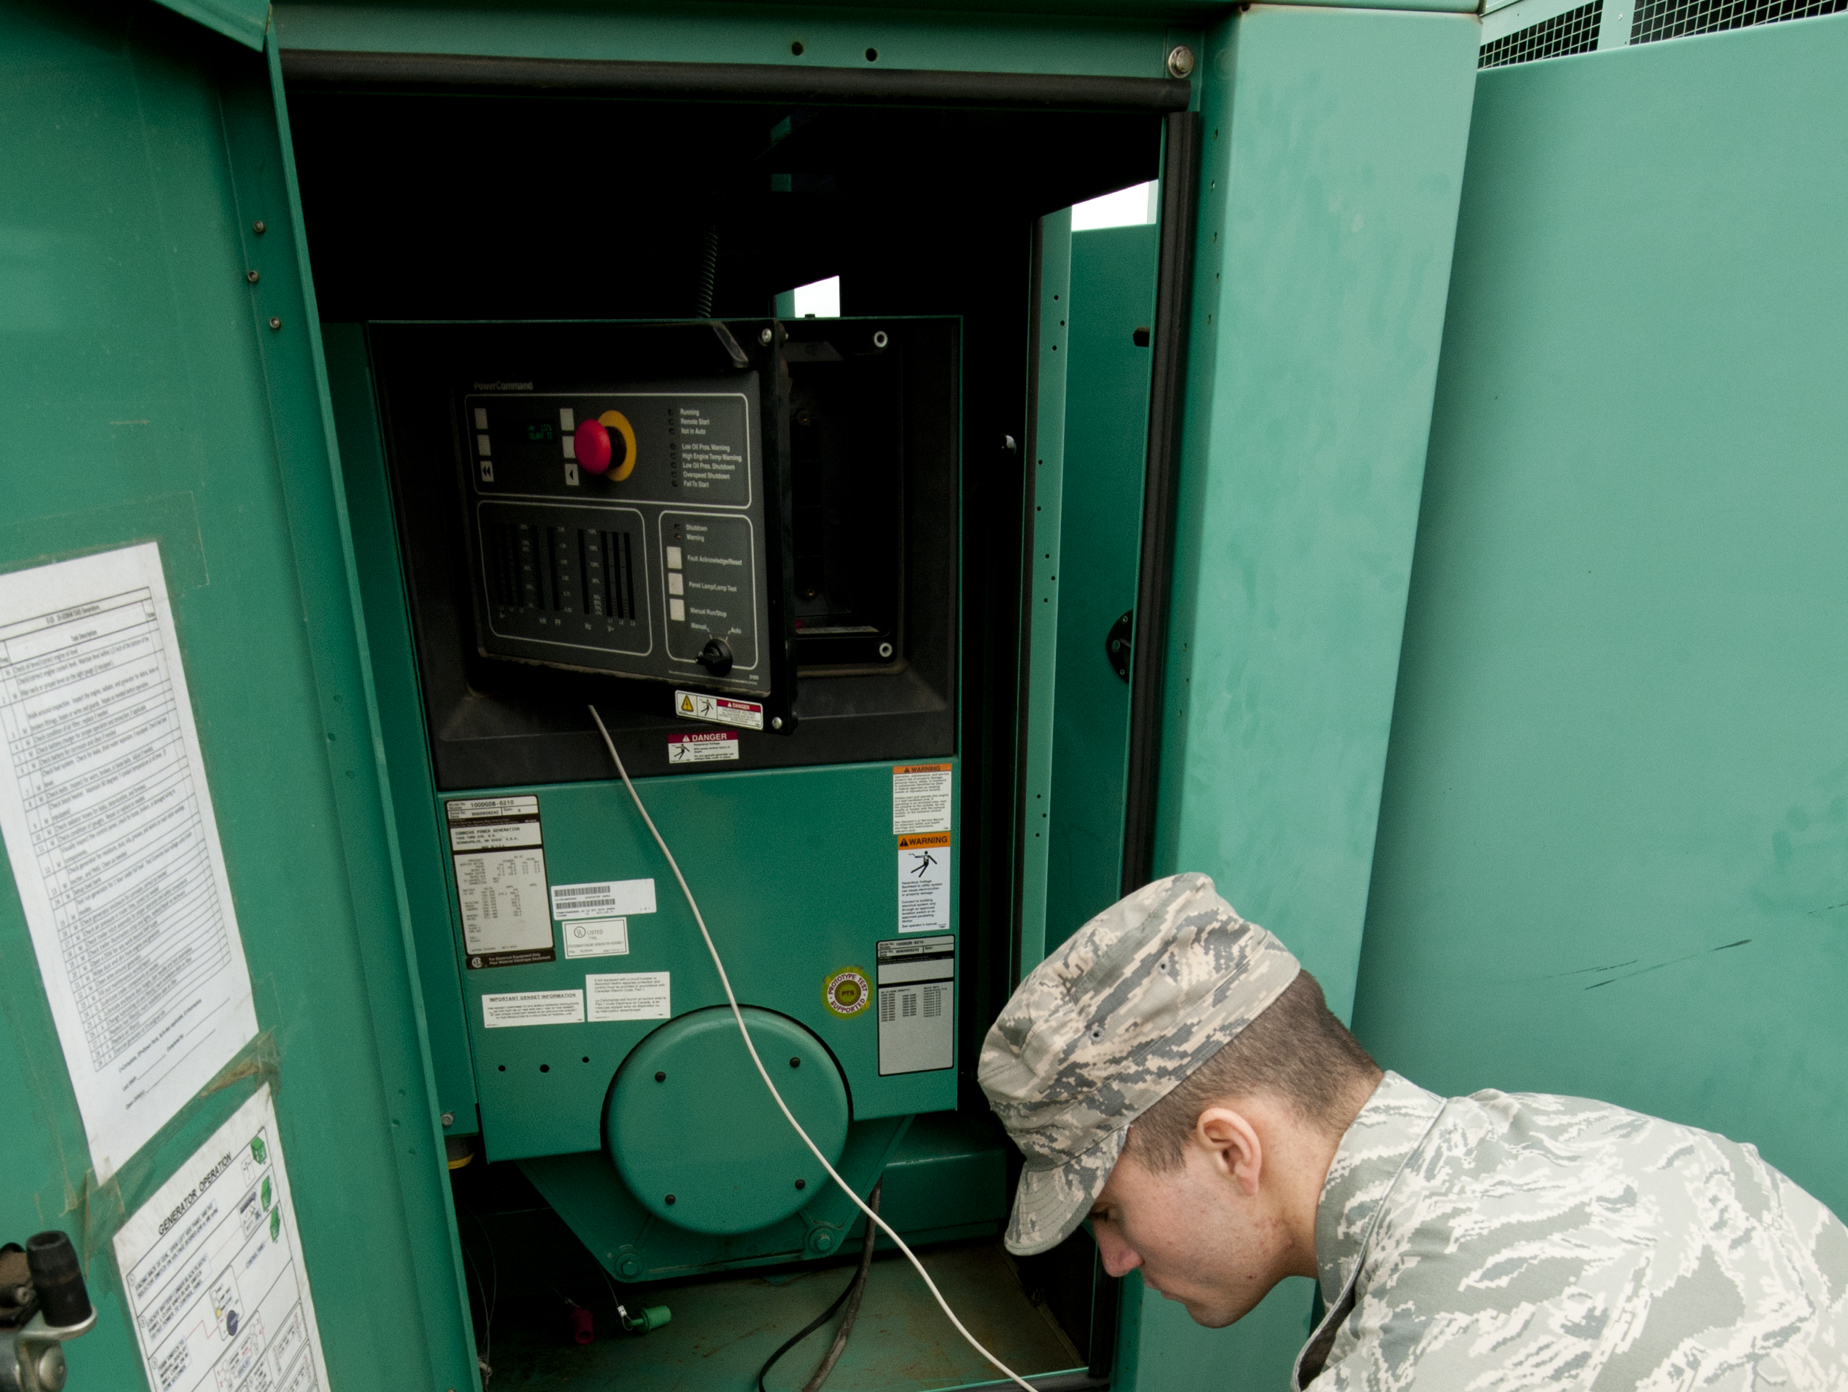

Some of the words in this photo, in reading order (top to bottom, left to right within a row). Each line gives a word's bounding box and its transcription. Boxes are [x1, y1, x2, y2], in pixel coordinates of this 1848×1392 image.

[680, 409, 699, 417] Running
[711, 444, 730, 452] Warning
[694, 453, 709, 461] Engine
[722, 454, 742, 462] Warning
[683, 471, 706, 479] Overspeed
[686, 524, 707, 532] Shutdown
[686, 534, 704, 542] Warning
[692, 733, 727, 741] DANGER
[908, 835, 947, 845] WARNING
[828, 974, 856, 994] PROTOTYPE
[858, 977, 867, 991] TEST
[830, 998, 865, 1013] SUPPORTED
[157, 1187, 197, 1238] GENERATOR
[198, 1149, 232, 1194] OPERATION
